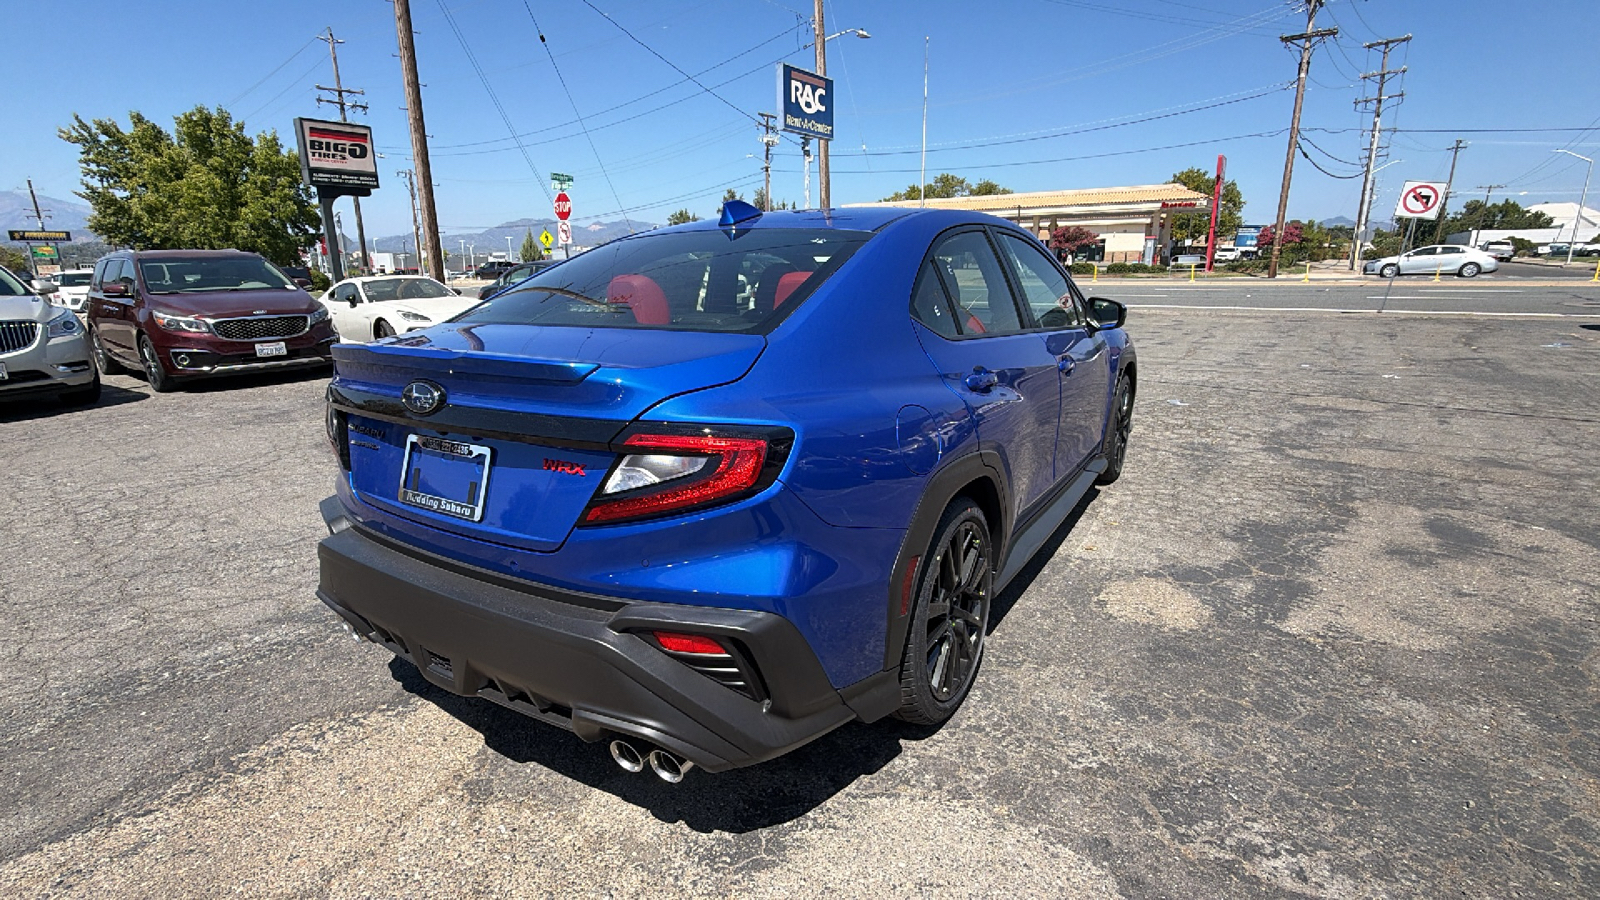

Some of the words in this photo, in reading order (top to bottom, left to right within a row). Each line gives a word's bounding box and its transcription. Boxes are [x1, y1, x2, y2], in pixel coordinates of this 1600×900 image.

[791, 80, 825, 114] RAC
[310, 151, 347, 160] TIRES
[555, 202, 571, 213] STOP
[348, 423, 386, 439] SUBARU
[543, 458, 587, 476] WRX
[406, 491, 439, 509] Redding
[440, 500, 472, 516] Subaru
